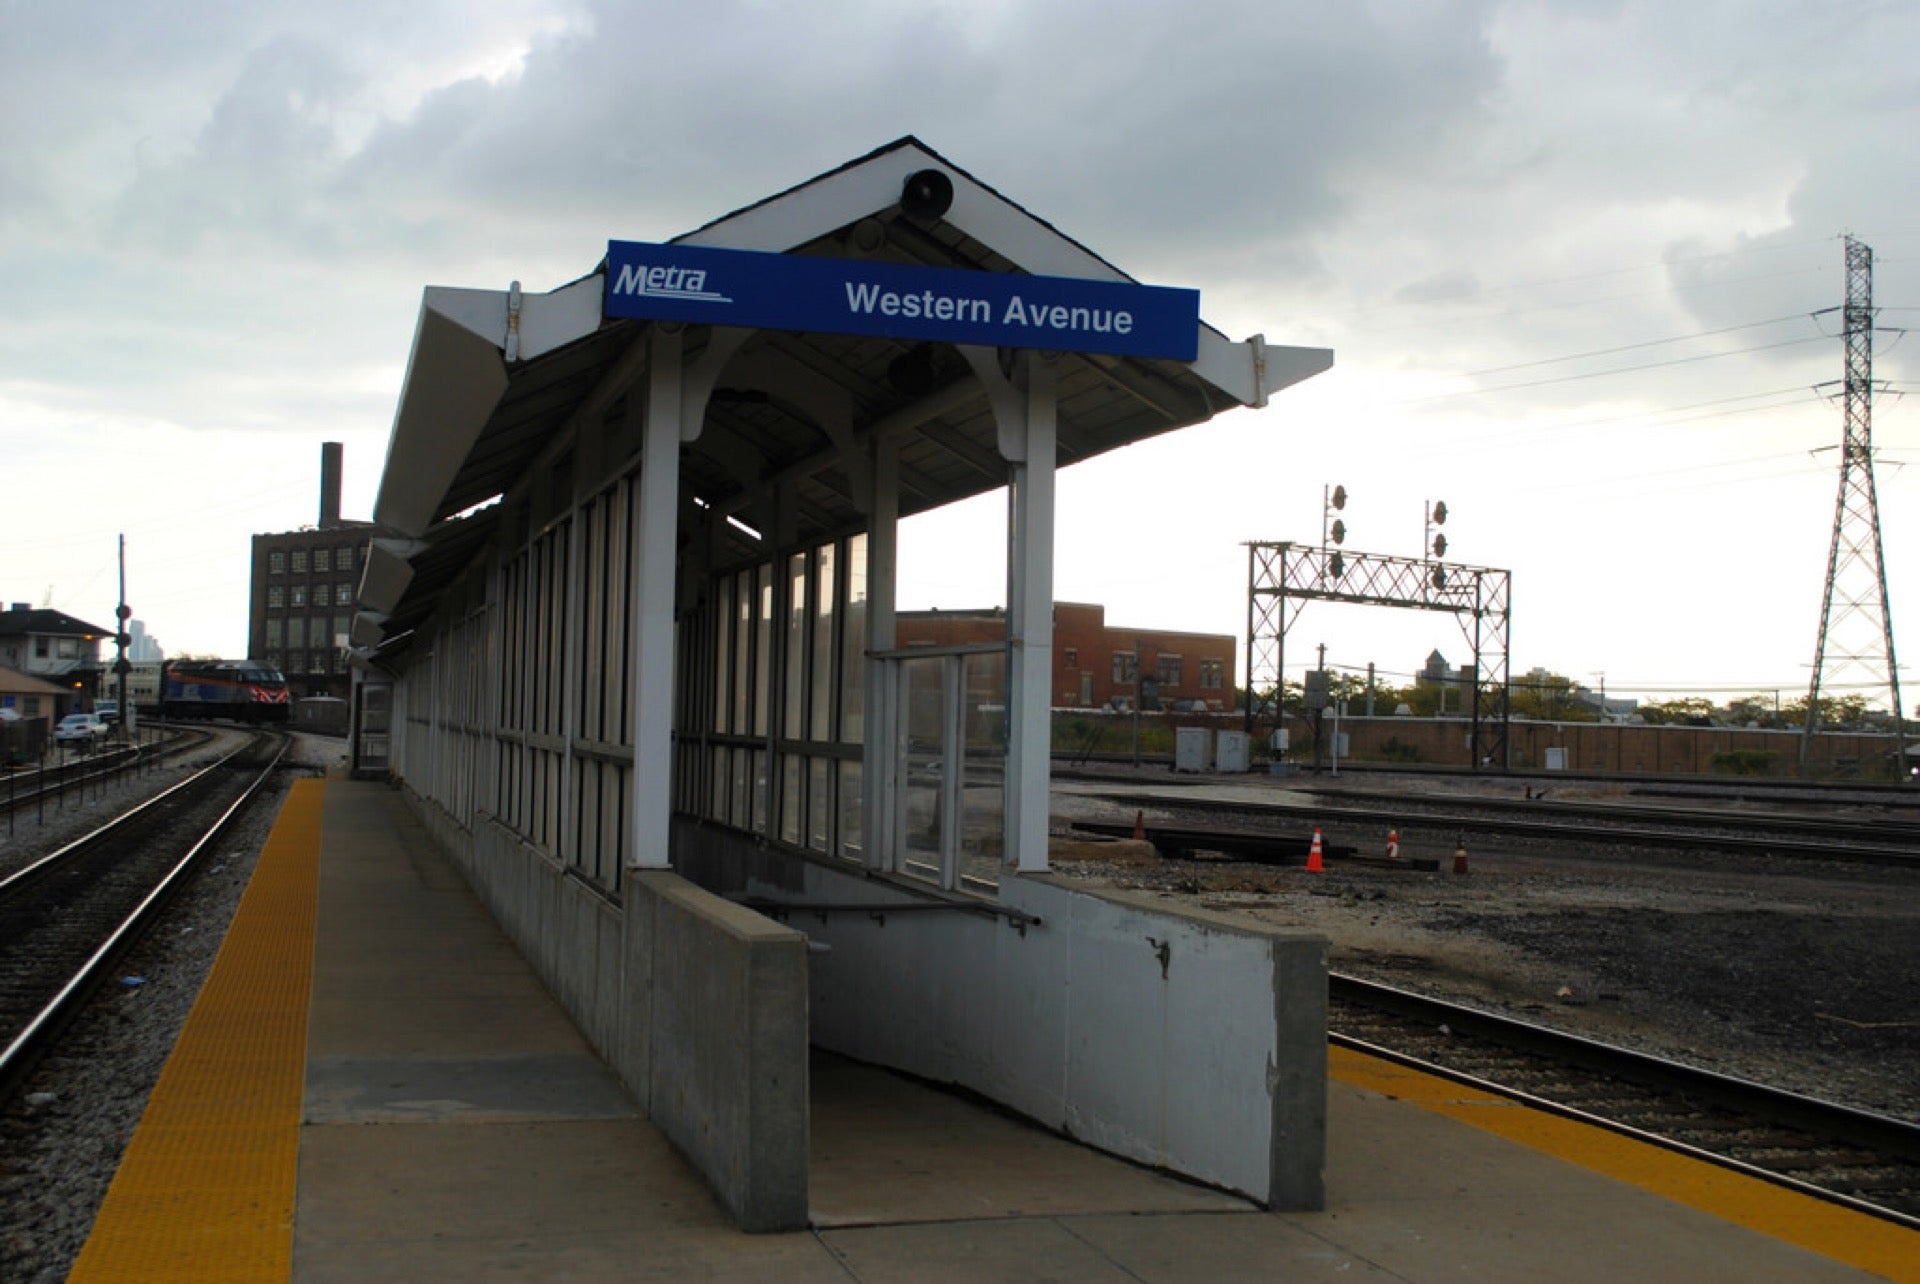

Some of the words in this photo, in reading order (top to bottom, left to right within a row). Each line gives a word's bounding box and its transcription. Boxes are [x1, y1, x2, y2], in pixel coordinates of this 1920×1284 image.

[613, 264, 707, 297] Metra
[845, 282, 991, 323] Western
[1002, 295, 1133, 334] Avenue
